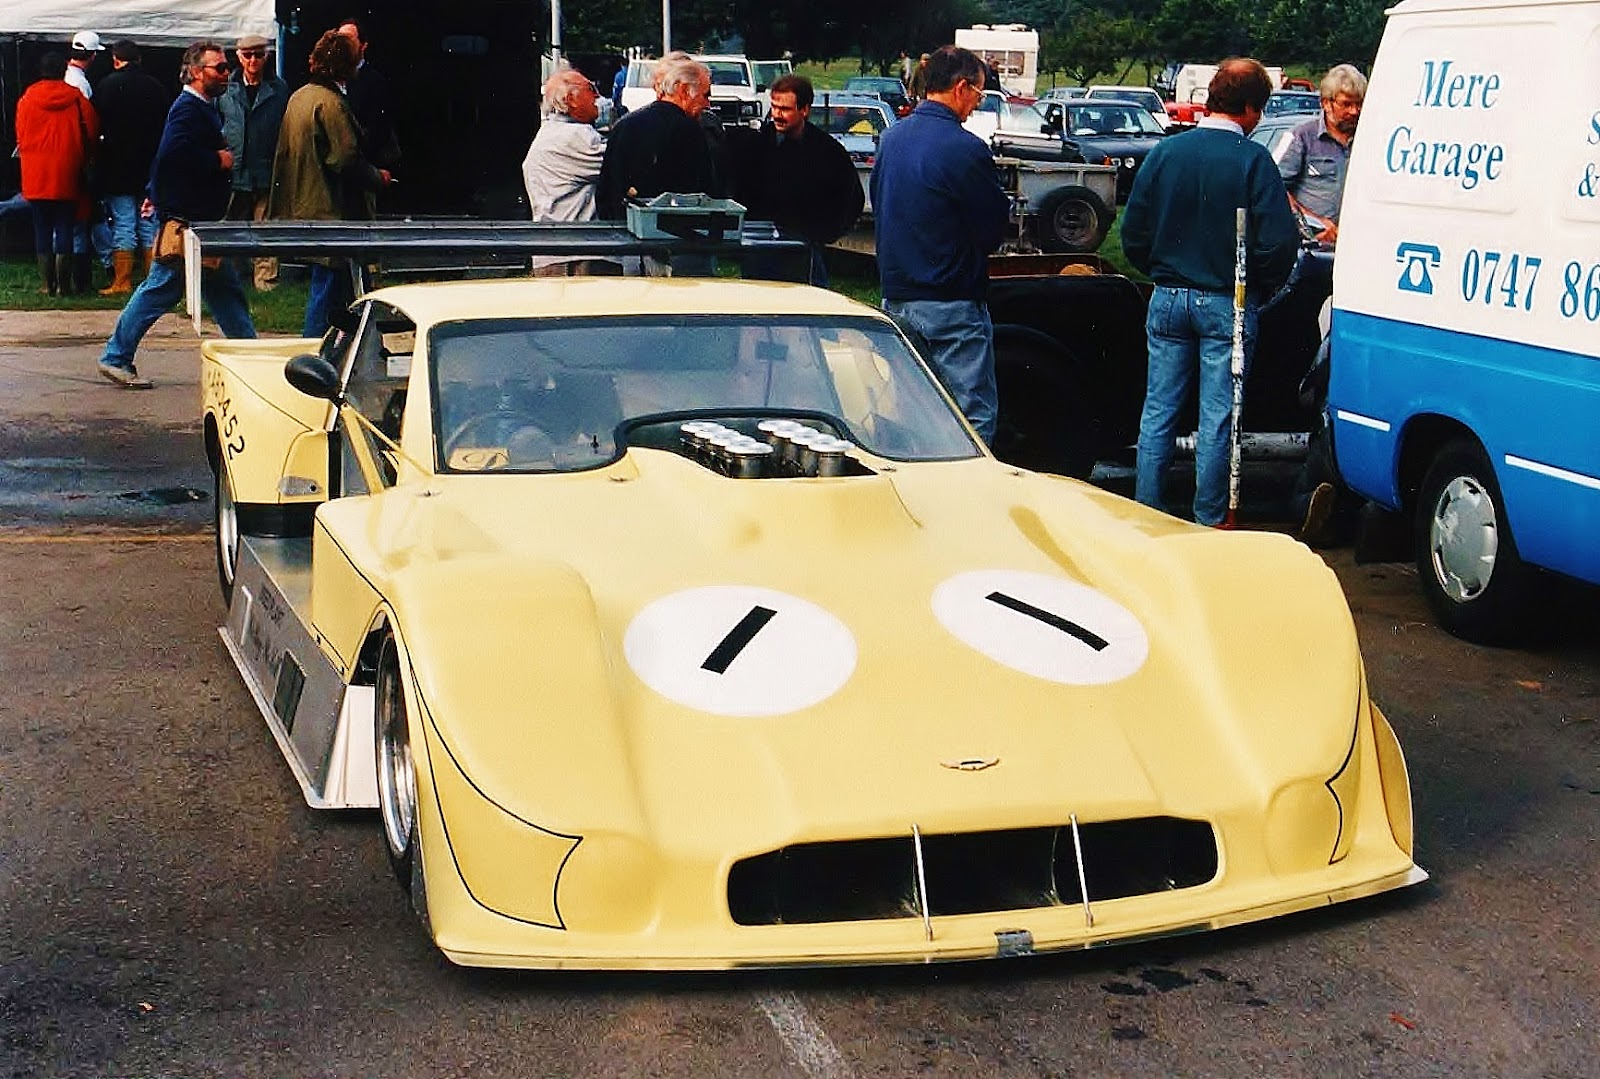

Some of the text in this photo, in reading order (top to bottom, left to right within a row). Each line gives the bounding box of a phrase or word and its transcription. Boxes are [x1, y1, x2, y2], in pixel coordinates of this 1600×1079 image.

[1413, 60, 1501, 109] Mere
[1385, 125, 1504, 190] Garage
[1461, 248, 1600, 322] 0747 86
[700, 605, 778, 675] 1
